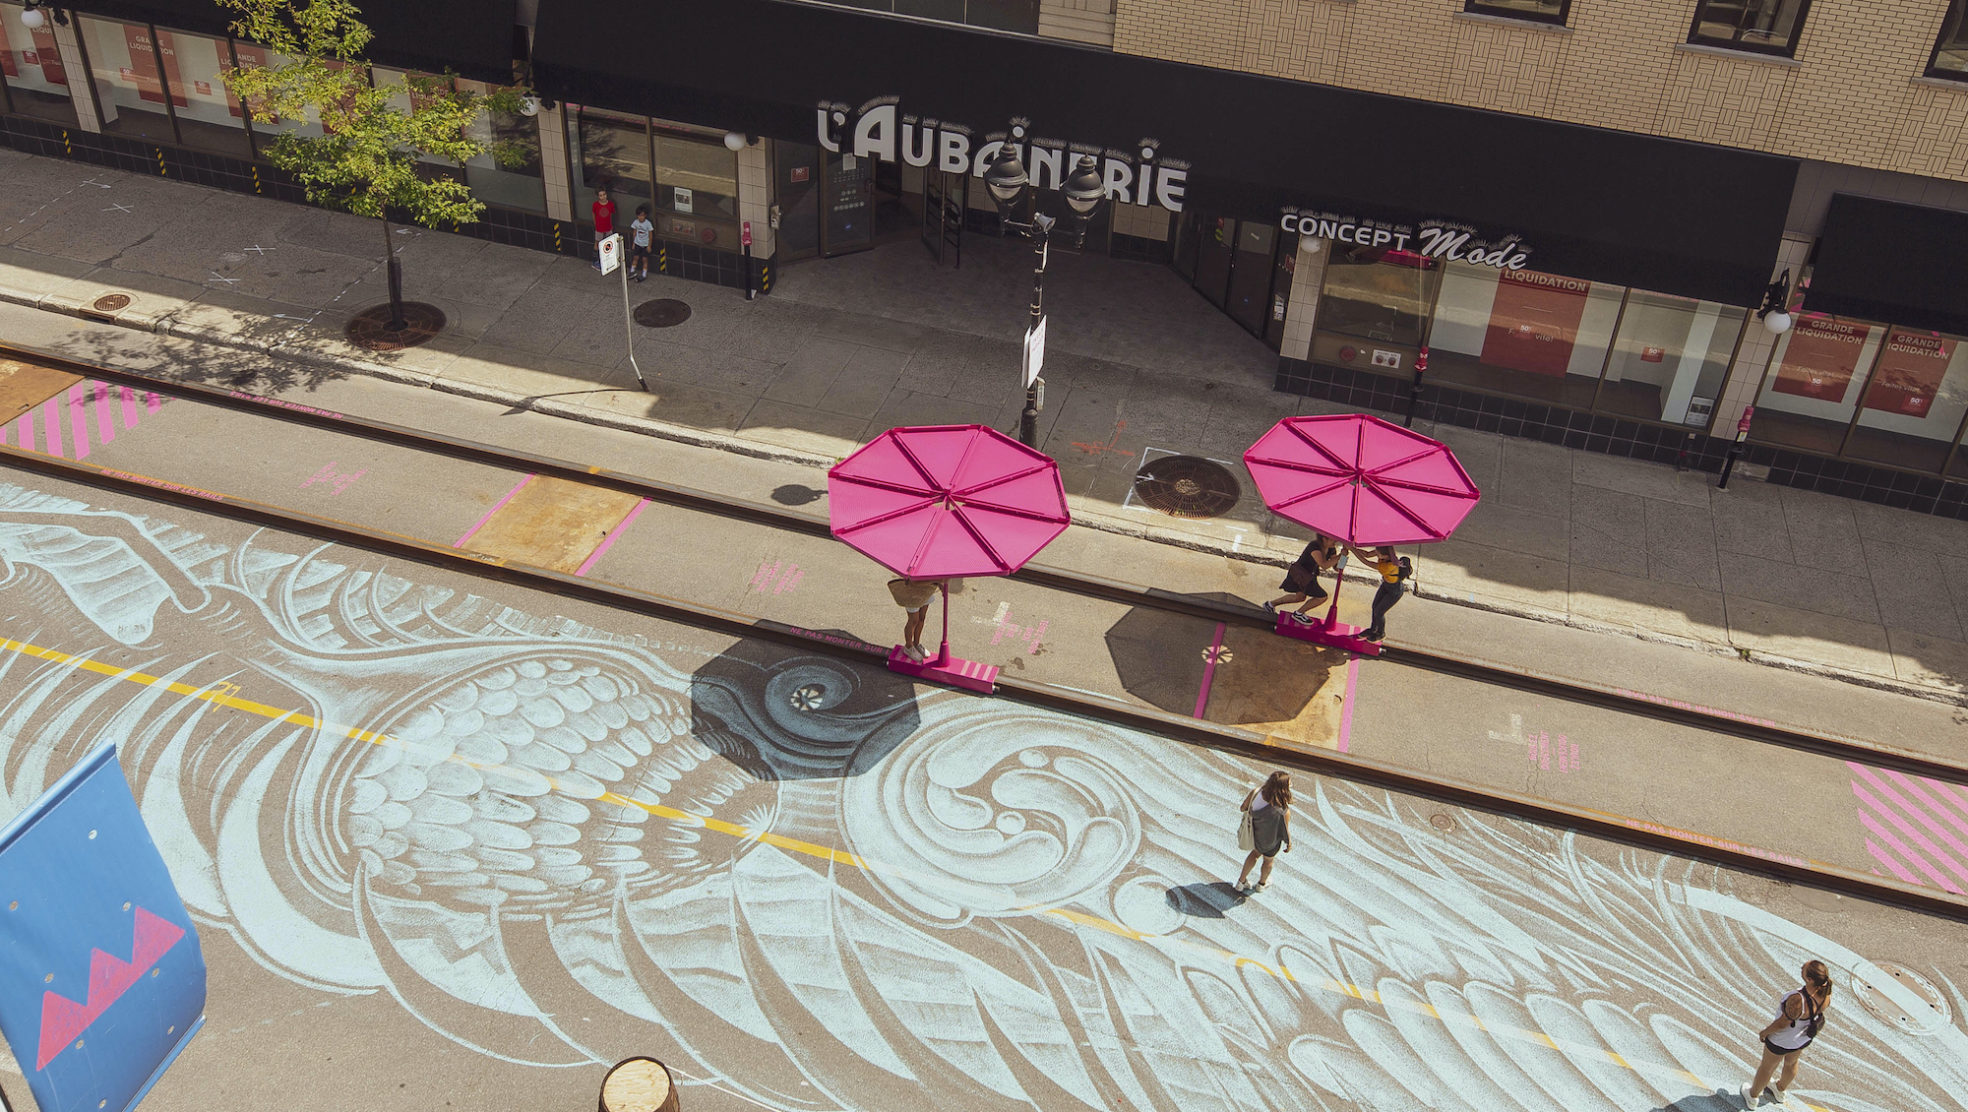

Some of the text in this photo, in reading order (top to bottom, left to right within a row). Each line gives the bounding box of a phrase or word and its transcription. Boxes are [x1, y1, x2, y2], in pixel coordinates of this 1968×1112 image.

[1281, 214, 1528, 270] CONCEPT Mode
[1504, 270, 1586, 291] LIQUIDATION
[1811, 320, 1854, 334] GRANDE
[1797, 328, 1862, 344] LIQUIDATION
[1897, 335, 1941, 348] GRANDE
[1888, 343, 1950, 359] IQUIDATION
[113, 471, 129, 480] PAS
[163, 483, 181, 491] SUR
[181, 487, 198, 495] LES
[198, 491, 225, 502] RAILS
[790, 627, 803, 635] NE
[804, 630, 822, 640] PAS
[825, 635, 862, 649] MONTER
[864, 644, 883, 653] SUR
[1672, 699, 1691, 710] SUR
[1696, 705, 1735, 719] MONTER
[1625, 818, 1804, 866] NE PAS MONTER SUR LES RAILS
